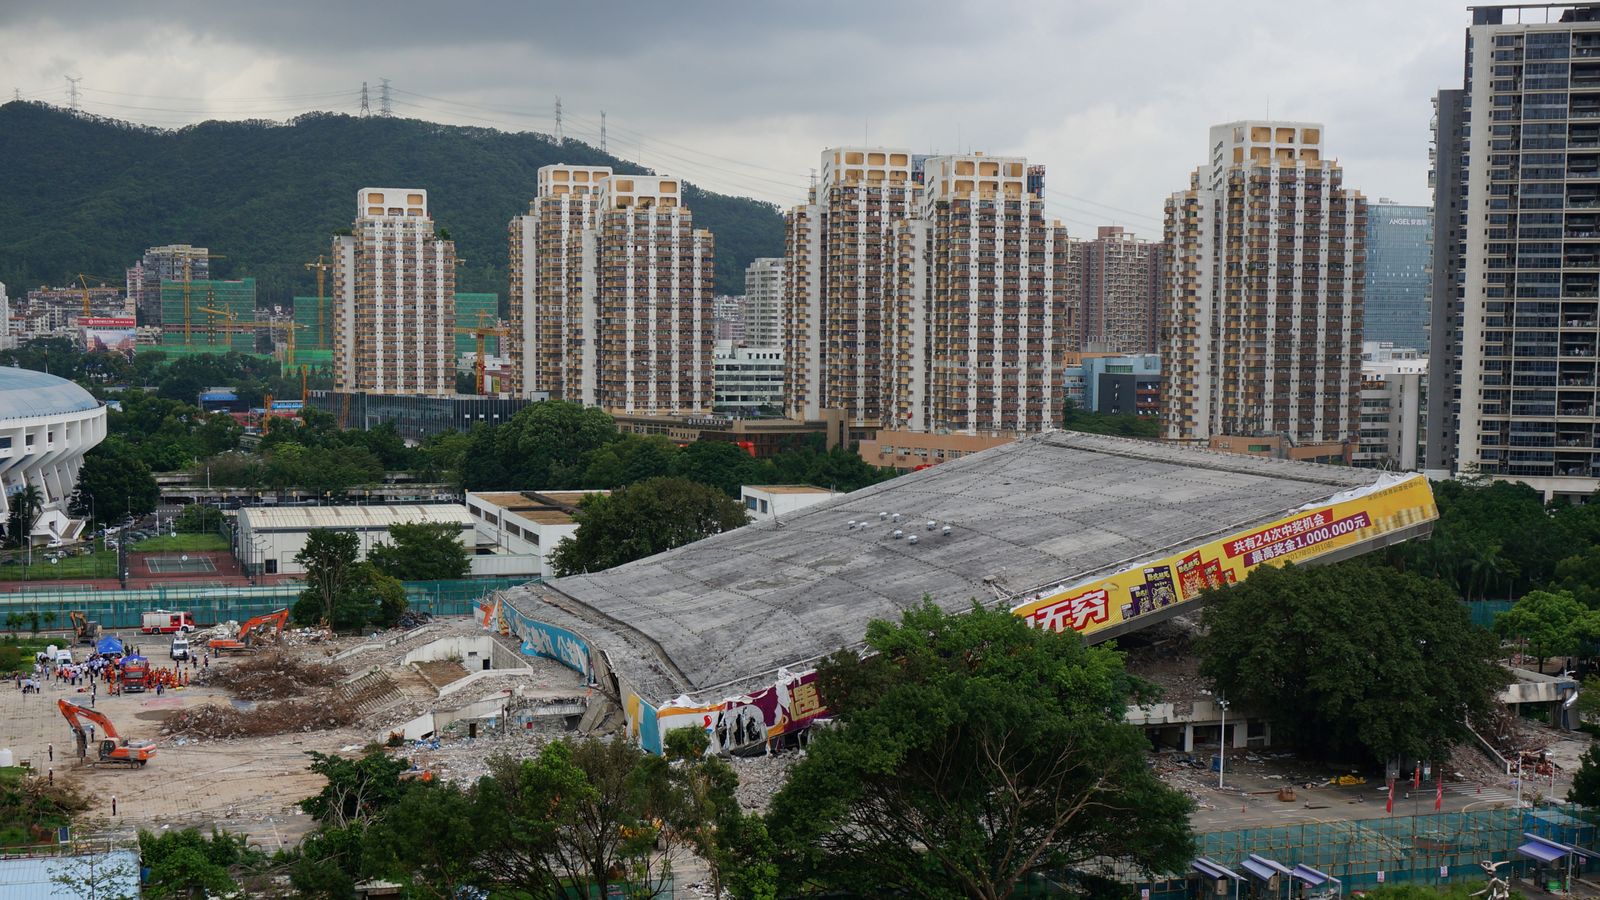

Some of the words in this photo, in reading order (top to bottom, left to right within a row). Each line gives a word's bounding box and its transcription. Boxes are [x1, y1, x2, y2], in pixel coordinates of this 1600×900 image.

[1233, 513, 1325, 554] 共有24次中奖机会
[1251, 515, 1366, 565] 最高奖金1,000,000元
